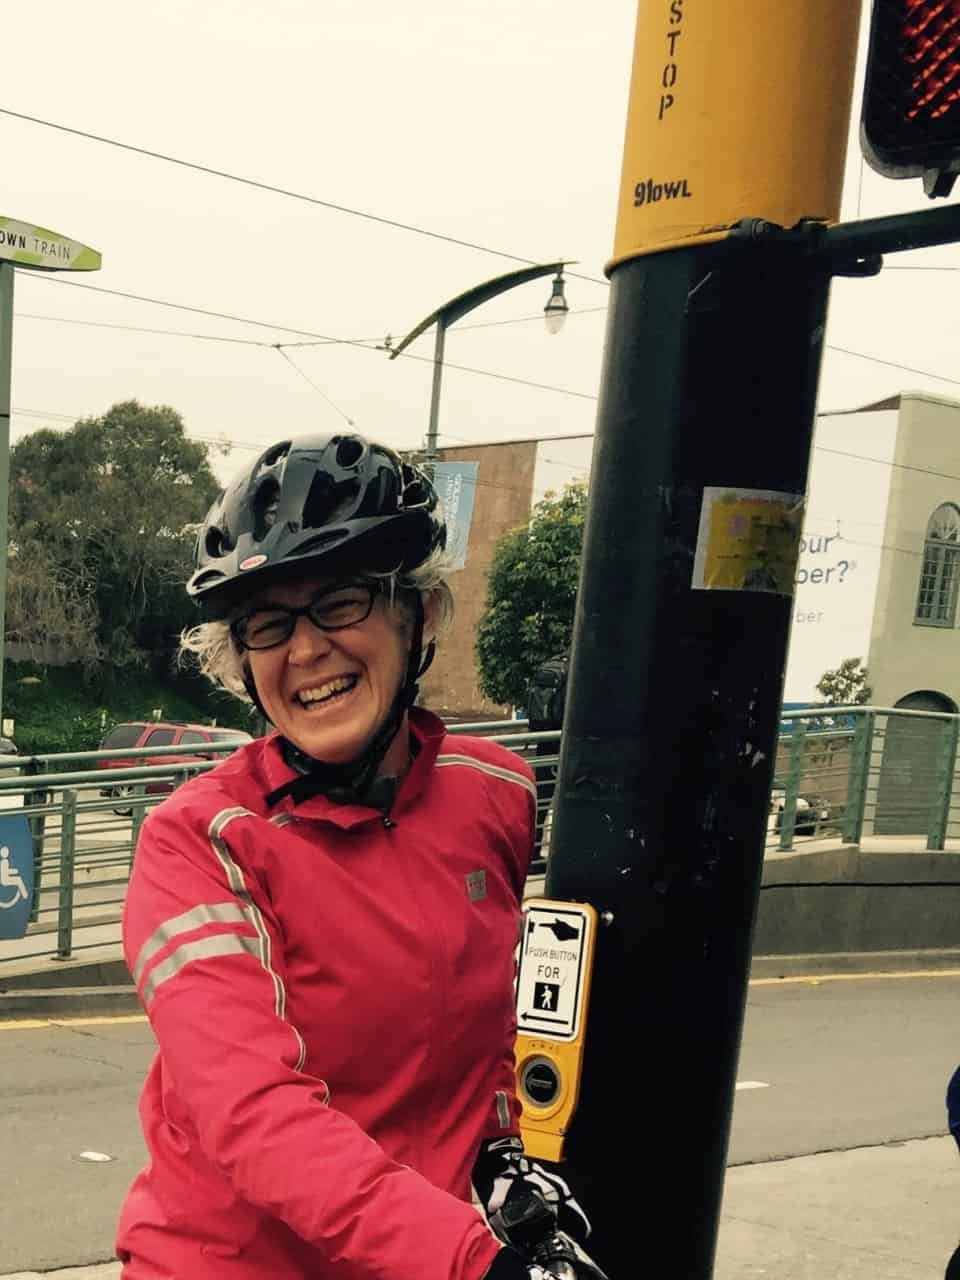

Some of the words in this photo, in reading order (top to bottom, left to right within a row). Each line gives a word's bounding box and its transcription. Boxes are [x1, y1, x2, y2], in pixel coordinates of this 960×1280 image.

[658, 0, 683, 120] STOP
[33, 238, 71, 260] TRAIN
[529, 947, 549, 959] PUSH
[550, 949, 578, 961] BUTTON
[537, 964, 561, 979] FOR
